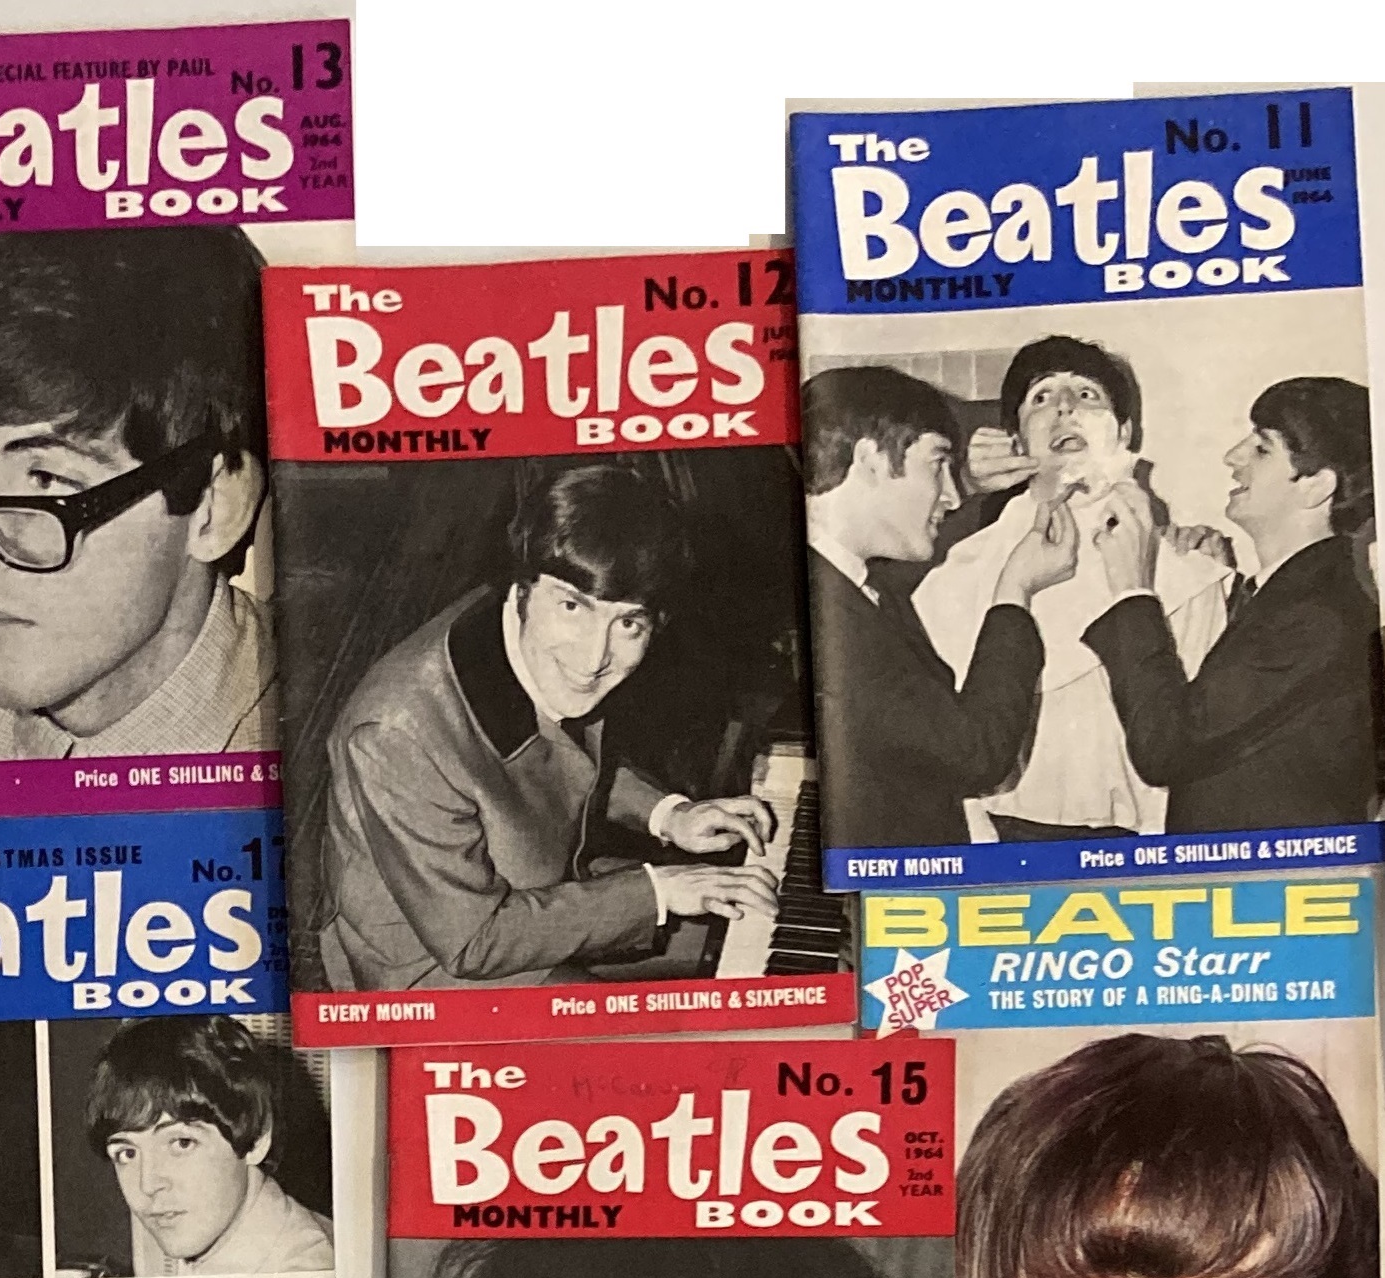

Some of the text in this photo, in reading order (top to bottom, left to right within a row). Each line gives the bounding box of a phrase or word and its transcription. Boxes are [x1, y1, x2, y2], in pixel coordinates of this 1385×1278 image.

[53, 60, 131, 79] FEATURE
[137, 60, 158, 78] BY
[167, 58, 215, 77] PAUL
[230, 42, 344, 95] No. 13
[1165, 103, 1312, 154] No. 11
[829, 134, 930, 162] The
[105, 187, 288, 219] BOOK
[831, 150, 1295, 281] Beatles
[645, 261, 792, 311] No. 12
[1104, 255, 1291, 294] BOOK
[302, 285, 403, 313] The
[305, 305, 765, 428] Beatles
[576, 412, 759, 446] BOOK
[75, 845, 143, 866] ISSUE
[864, 884, 1359, 948] BEATLE
[885, 964, 923, 992] POP
[990, 947, 1270, 983] RINGO Starr
[73, 978, 256, 1010] BOOK
[888, 977, 936, 1012] PICS
[888, 990, 954, 1030] SUPER
[989, 981, 1335, 1009] THE STORY OF A RING-A-DING STAR
[423, 1062, 527, 1089] The
[778, 1062, 853, 1097] No.
[872, 1061, 927, 1105] 15
[425, 1089, 890, 1205] Beatles
[695, 1201, 883, 1229] BOOK
